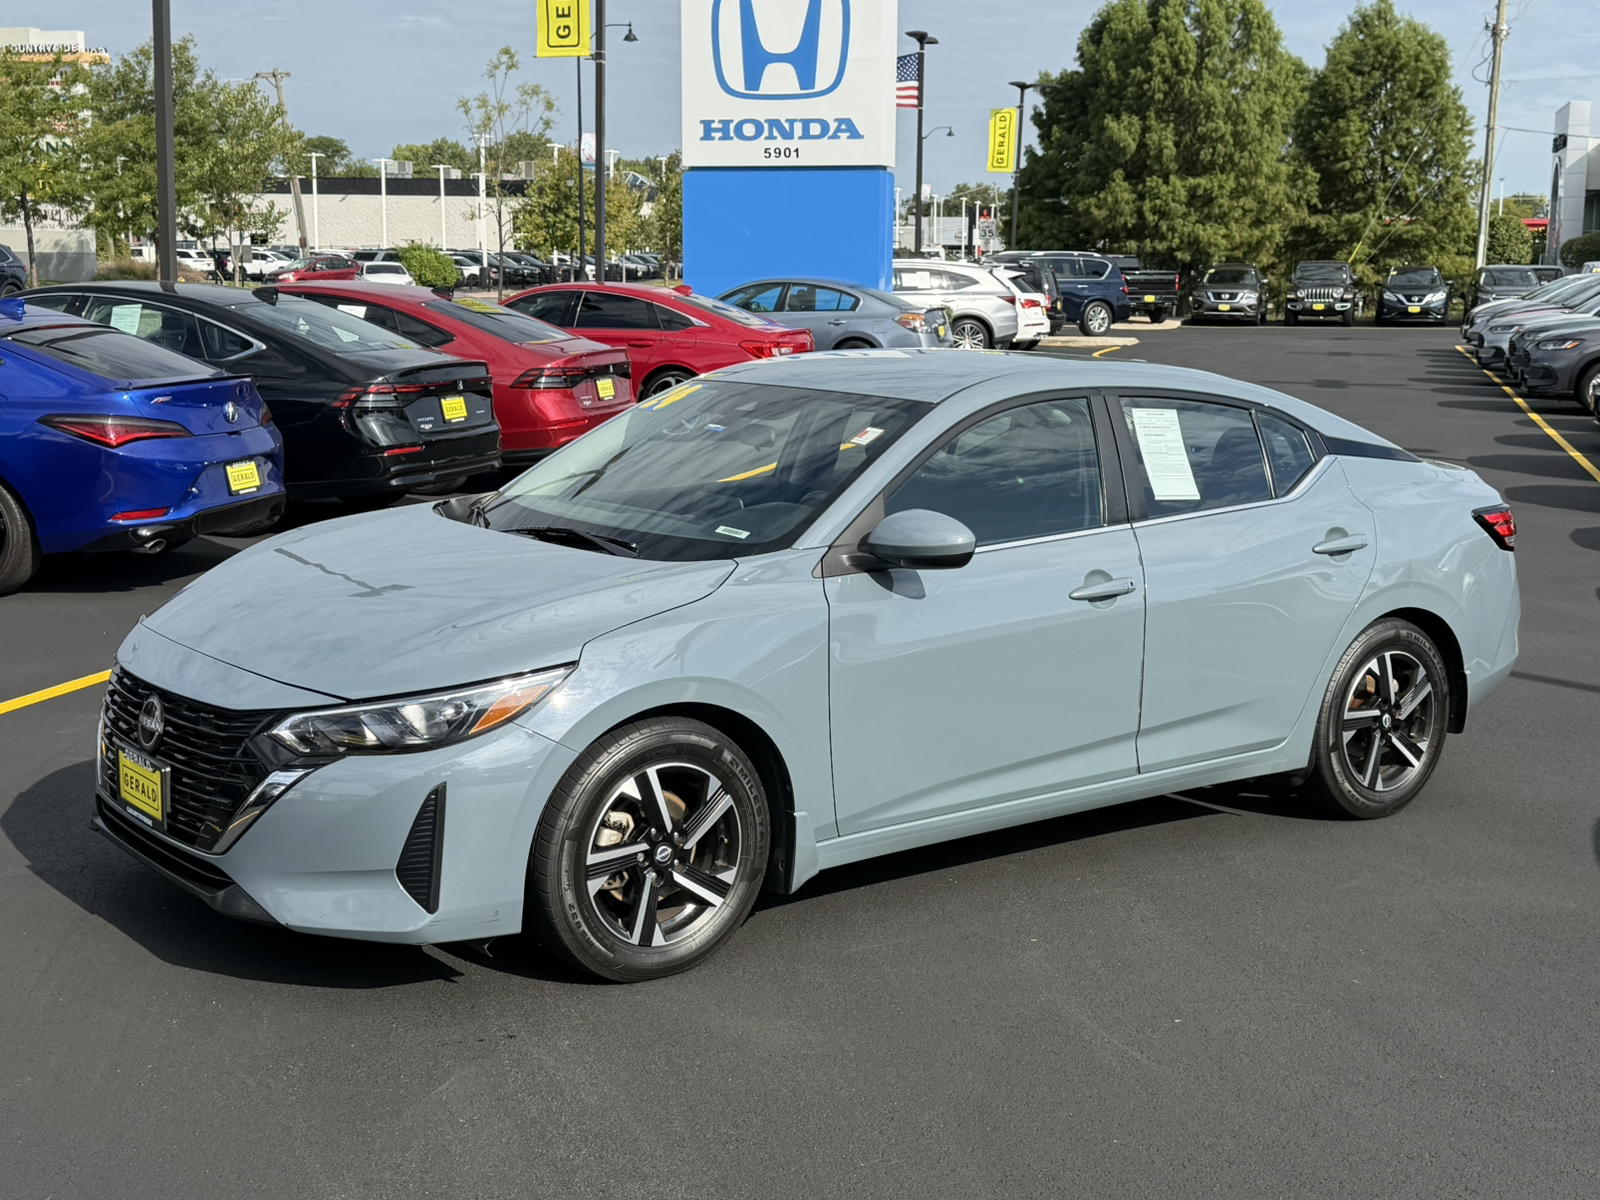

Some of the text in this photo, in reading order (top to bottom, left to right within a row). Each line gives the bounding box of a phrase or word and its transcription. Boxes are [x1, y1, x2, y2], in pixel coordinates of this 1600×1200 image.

[3, 43, 79, 54] COUNTRYSIDE
[699, 117, 865, 141] HONDA
[996, 115, 1007, 164] GERALD
[764, 147, 800, 159] 5901
[980, 229, 994, 238] 35
[232, 471, 254, 483] GERALD
[124, 748, 153, 772] GERALD
[123, 772, 157, 803] GERALD
[738, 765, 765, 856] MILESTAR
